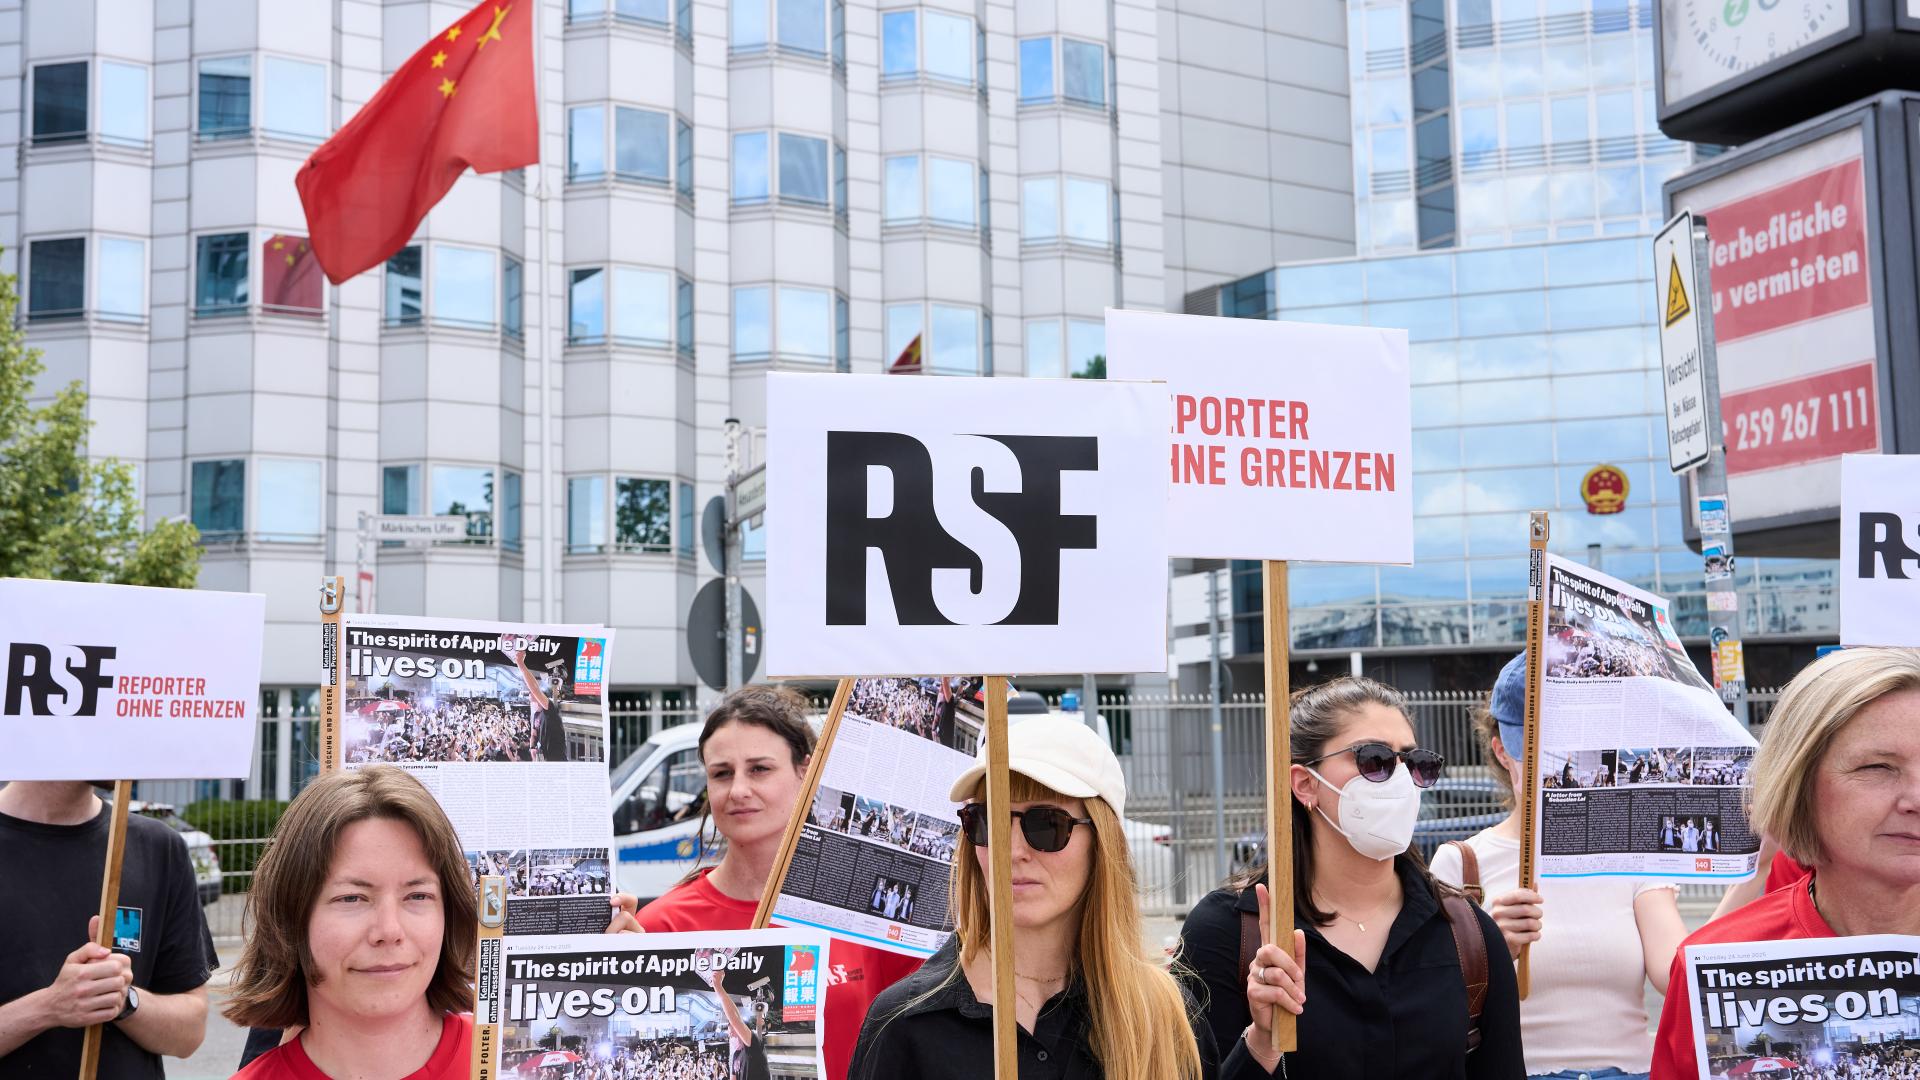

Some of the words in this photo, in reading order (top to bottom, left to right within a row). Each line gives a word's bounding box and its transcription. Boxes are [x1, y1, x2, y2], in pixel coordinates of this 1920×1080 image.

[1712, 290, 1723, 315] u
[1729, 250, 1860, 308] vermieten
[1666, 347, 1697, 387] Vorsicht!
[1170, 394, 1309, 440] PORTER
[1682, 395, 1697, 413] Nässe
[1736, 407, 1775, 451] 259
[1781, 397, 1821, 442] 267
[1829, 387, 1868, 432] 111
[1170, 443, 1226, 486] NE
[1241, 446, 1395, 492] GRENZEN
[381, 522, 432, 533] Märkisches
[434, 522, 455, 533] Ufer
[826, 430, 1099, 626] RSF
[1552, 568, 1570, 585] The
[1570, 579, 1592, 596] spirit
[1592, 586, 1601, 598] of
[1600, 589, 1625, 607] Apple
[1625, 598, 1646, 617] Daily
[1552, 583, 1594, 618] lives
[350, 631, 385, 647] The
[388, 634, 439, 652] spirit
[440, 634, 459, 650] of
[460, 635, 513, 654] Apple
[515, 638, 560, 656] Daily
[4, 642, 117, 717] RSF
[350, 648, 437, 678] lives
[442, 658, 486, 680] on
[118, 675, 206, 696] REPORTER
[116, 698, 163, 718] OHNE
[169, 699, 245, 719] GRENZEN
[480, 940, 489, 973] Freiheit
[490, 940, 500, 999] Pressefreiheit
[512, 959, 556, 980] The
[558, 956, 618, 981] spirit
[625, 954, 646, 974] of
[647, 953, 710, 976] Apple
[712, 952, 764, 974] Daily
[1702, 968, 1753, 988] The
[1756, 961, 1826, 989] spirit
[1828, 960, 1856, 980] of
[480, 975, 489, 999] Keine
[510, 982, 617, 1021] lives
[622, 984, 676, 1014] on
[490, 1001, 498, 1022] ohne
[1706, 991, 1831, 1029] lives
[1834, 986, 1901, 1020] on
[480, 1026, 491, 1063] FOLTER.
